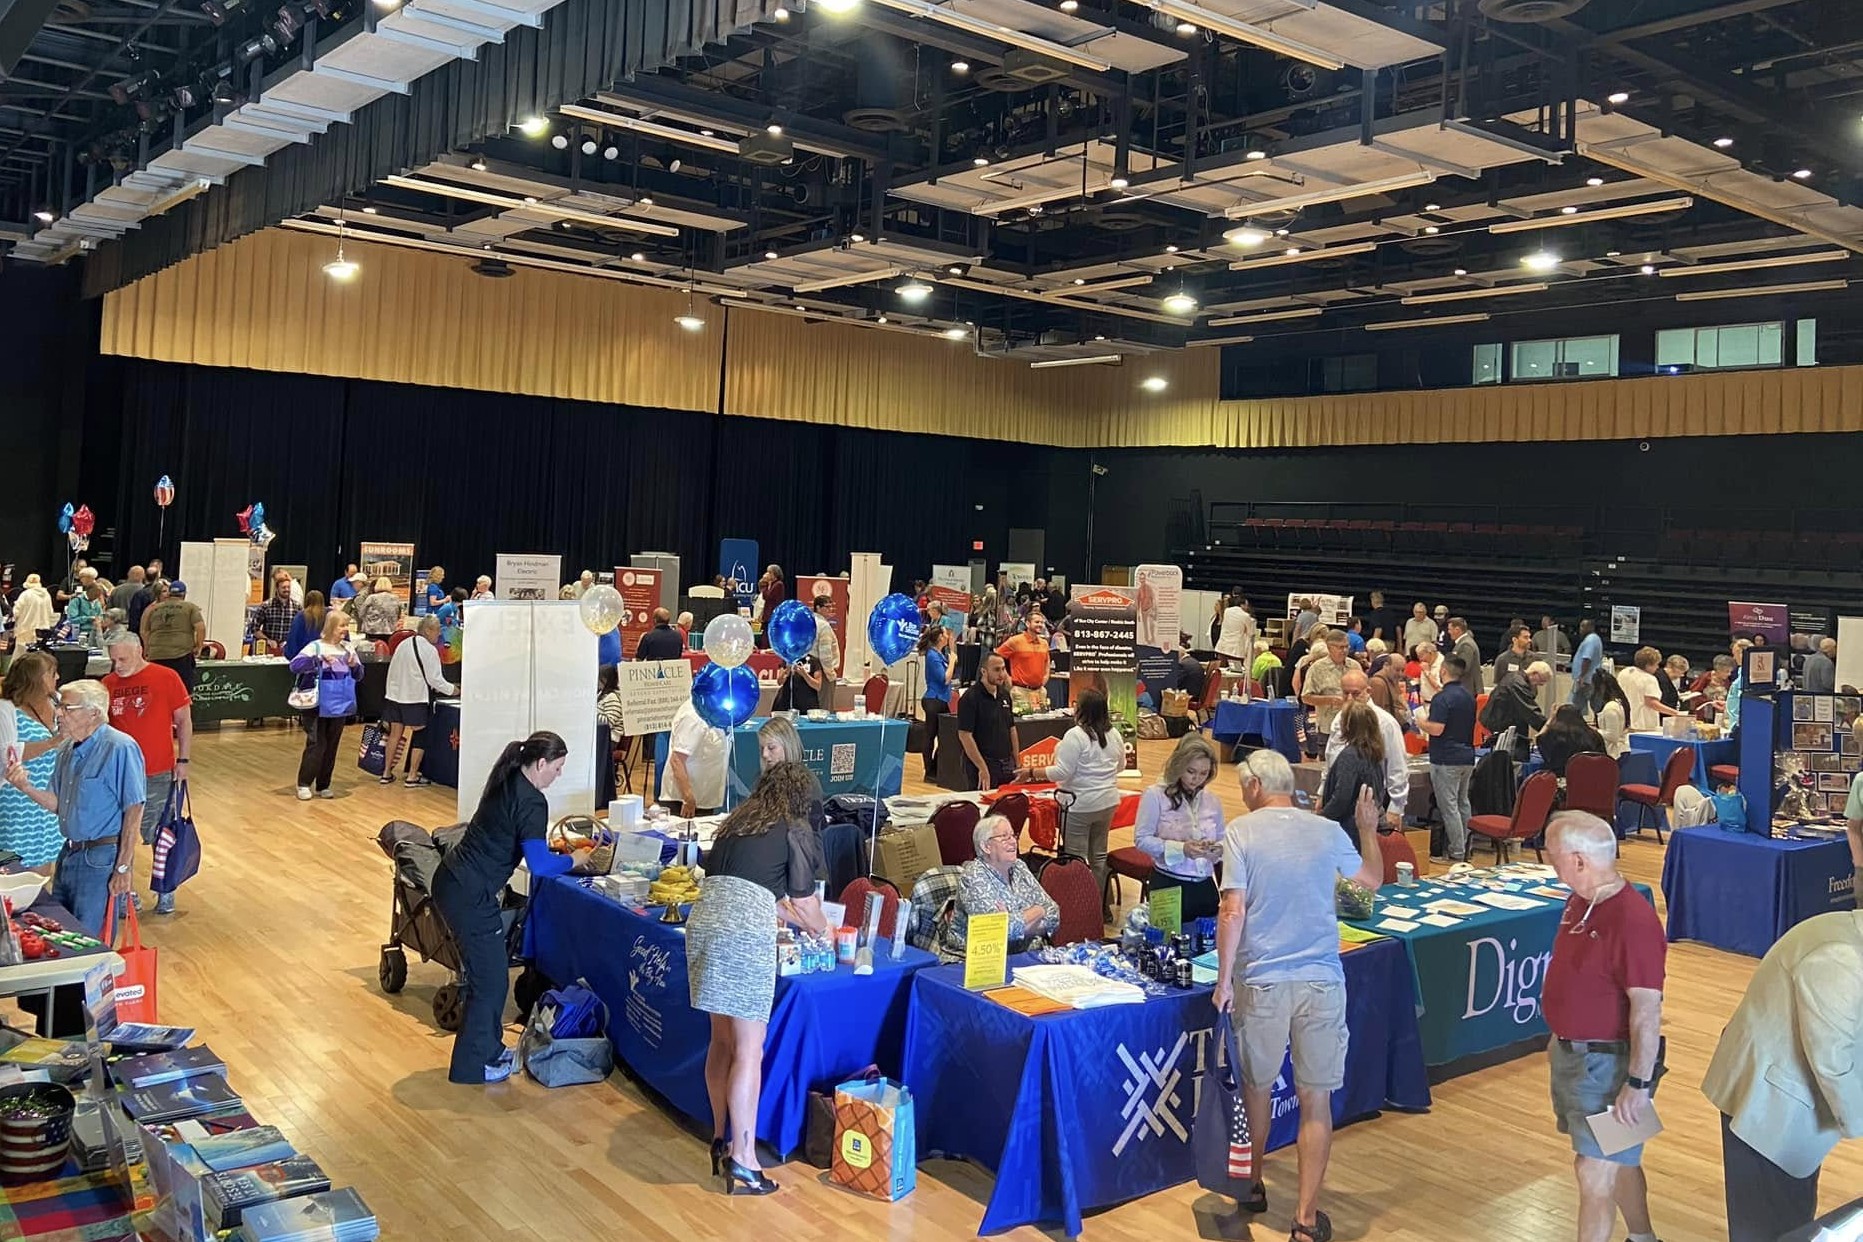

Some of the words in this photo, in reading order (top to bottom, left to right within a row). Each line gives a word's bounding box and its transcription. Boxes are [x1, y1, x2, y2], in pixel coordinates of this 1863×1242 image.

[364, 545, 412, 556] SUNROOMS
[1074, 630, 1134, 640] 813-867-2445
[629, 664, 684, 681] PINNACLE
[802, 749, 824, 762] CLE
[1023, 753, 1057, 768] SERV
[115, 988, 143, 999] evated
